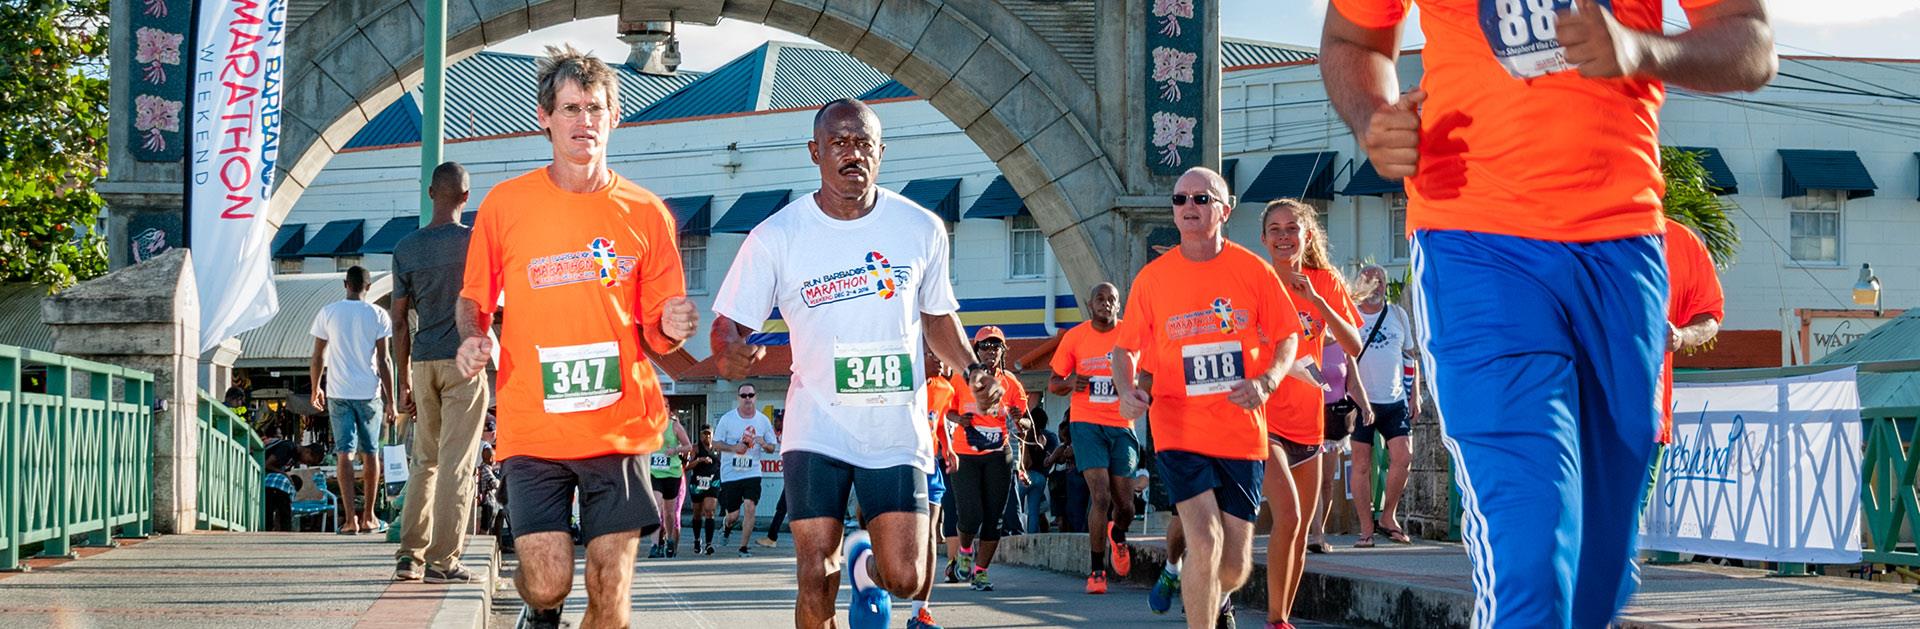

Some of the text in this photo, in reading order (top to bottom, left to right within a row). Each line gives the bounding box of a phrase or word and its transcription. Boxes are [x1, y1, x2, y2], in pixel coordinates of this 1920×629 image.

[267, 0, 284, 47] UN
[195, 43, 215, 186] WEEKEND
[219, 0, 265, 220] MARATHON
[532, 258, 594, 276] MARATHON
[803, 266, 866, 289] RUN BARBADOS
[805, 275, 868, 300] MARATHON
[551, 358, 606, 394] 347
[847, 355, 902, 389] 348
[1193, 352, 1236, 381] 818
[653, 456, 668, 466] 523
